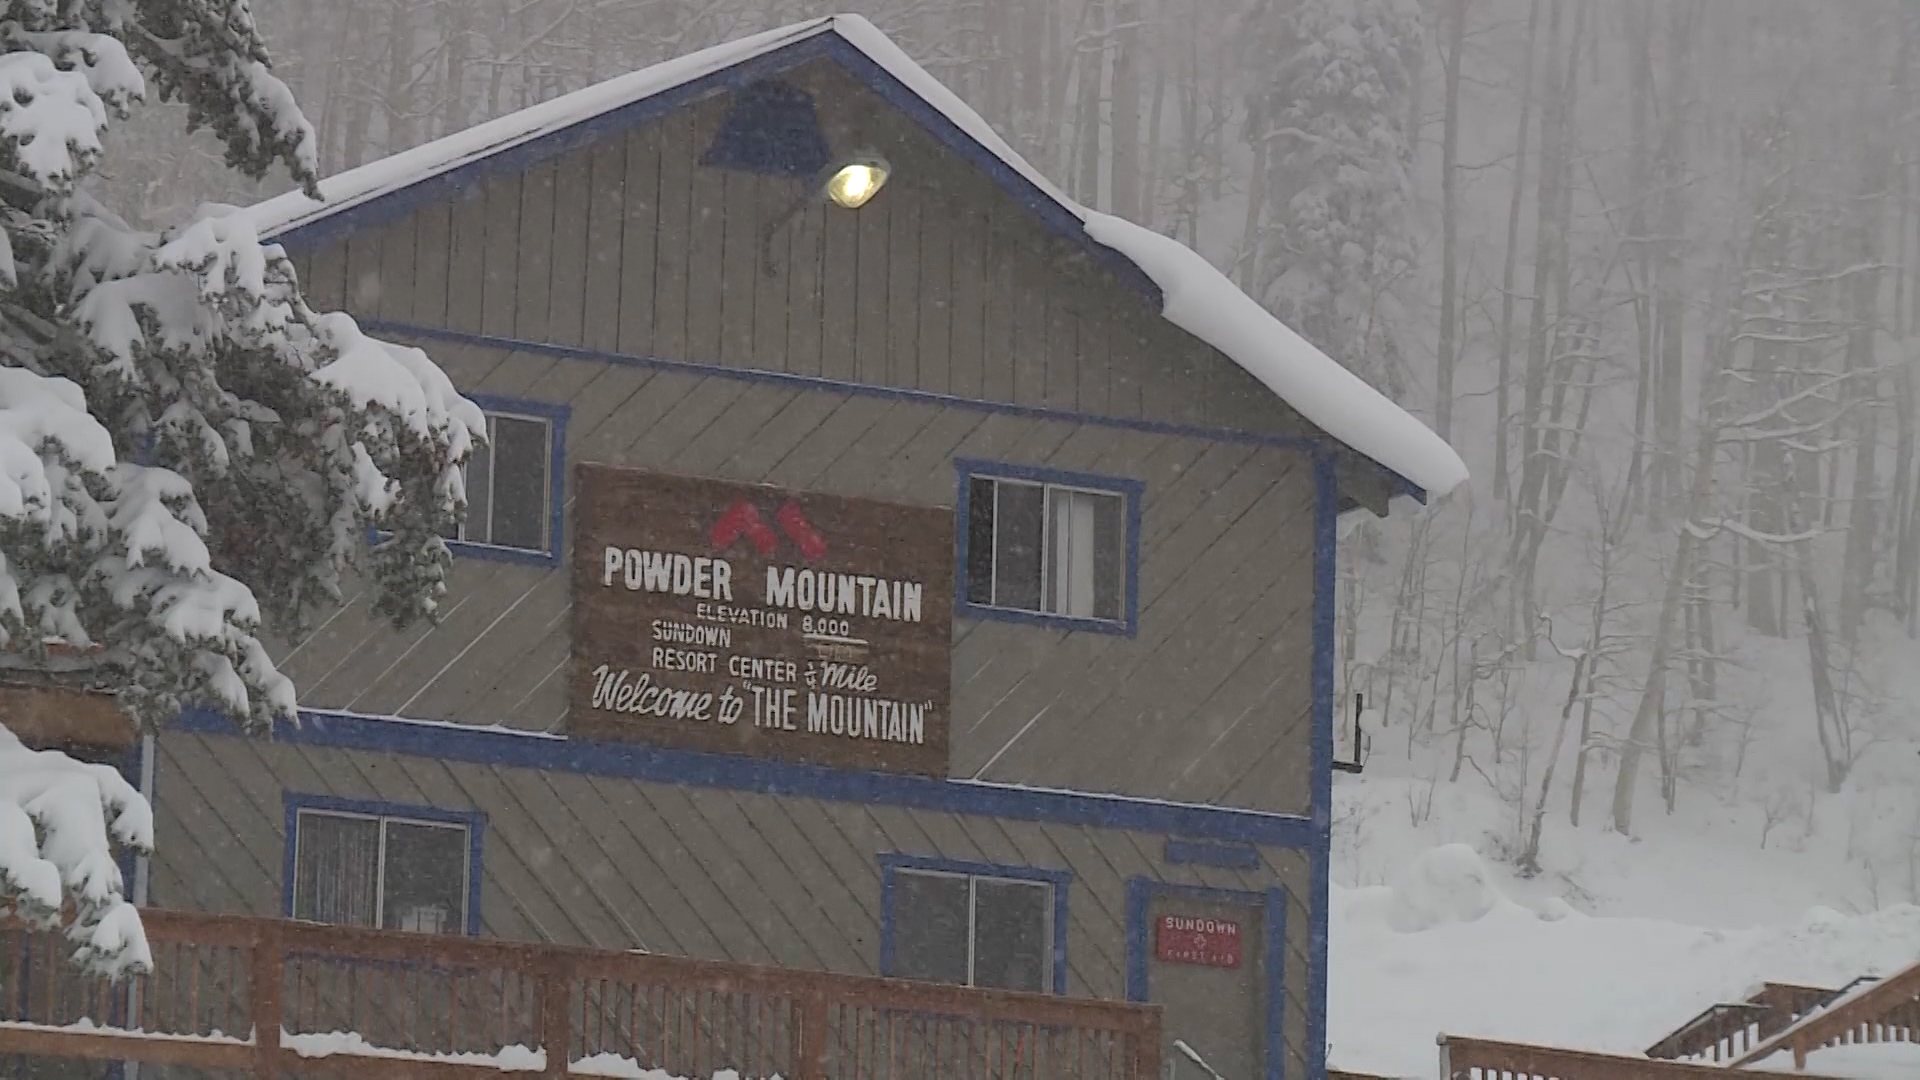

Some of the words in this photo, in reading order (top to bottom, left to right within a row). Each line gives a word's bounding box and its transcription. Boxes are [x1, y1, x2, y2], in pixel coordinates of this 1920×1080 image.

[603, 546, 733, 602] POWDER
[765, 565, 923, 623] MOUNTAIN
[651, 619, 732, 648] SUNDOWN
[696, 602, 788, 630] ELEVATION
[652, 647, 718, 674] RESORT
[728, 654, 798, 683] CENTER
[820, 660, 878, 692] Mile
[592, 664, 711, 721] Welcome
[717, 685, 744, 725] to
[1165, 916, 1236, 936] SUNDOWN
